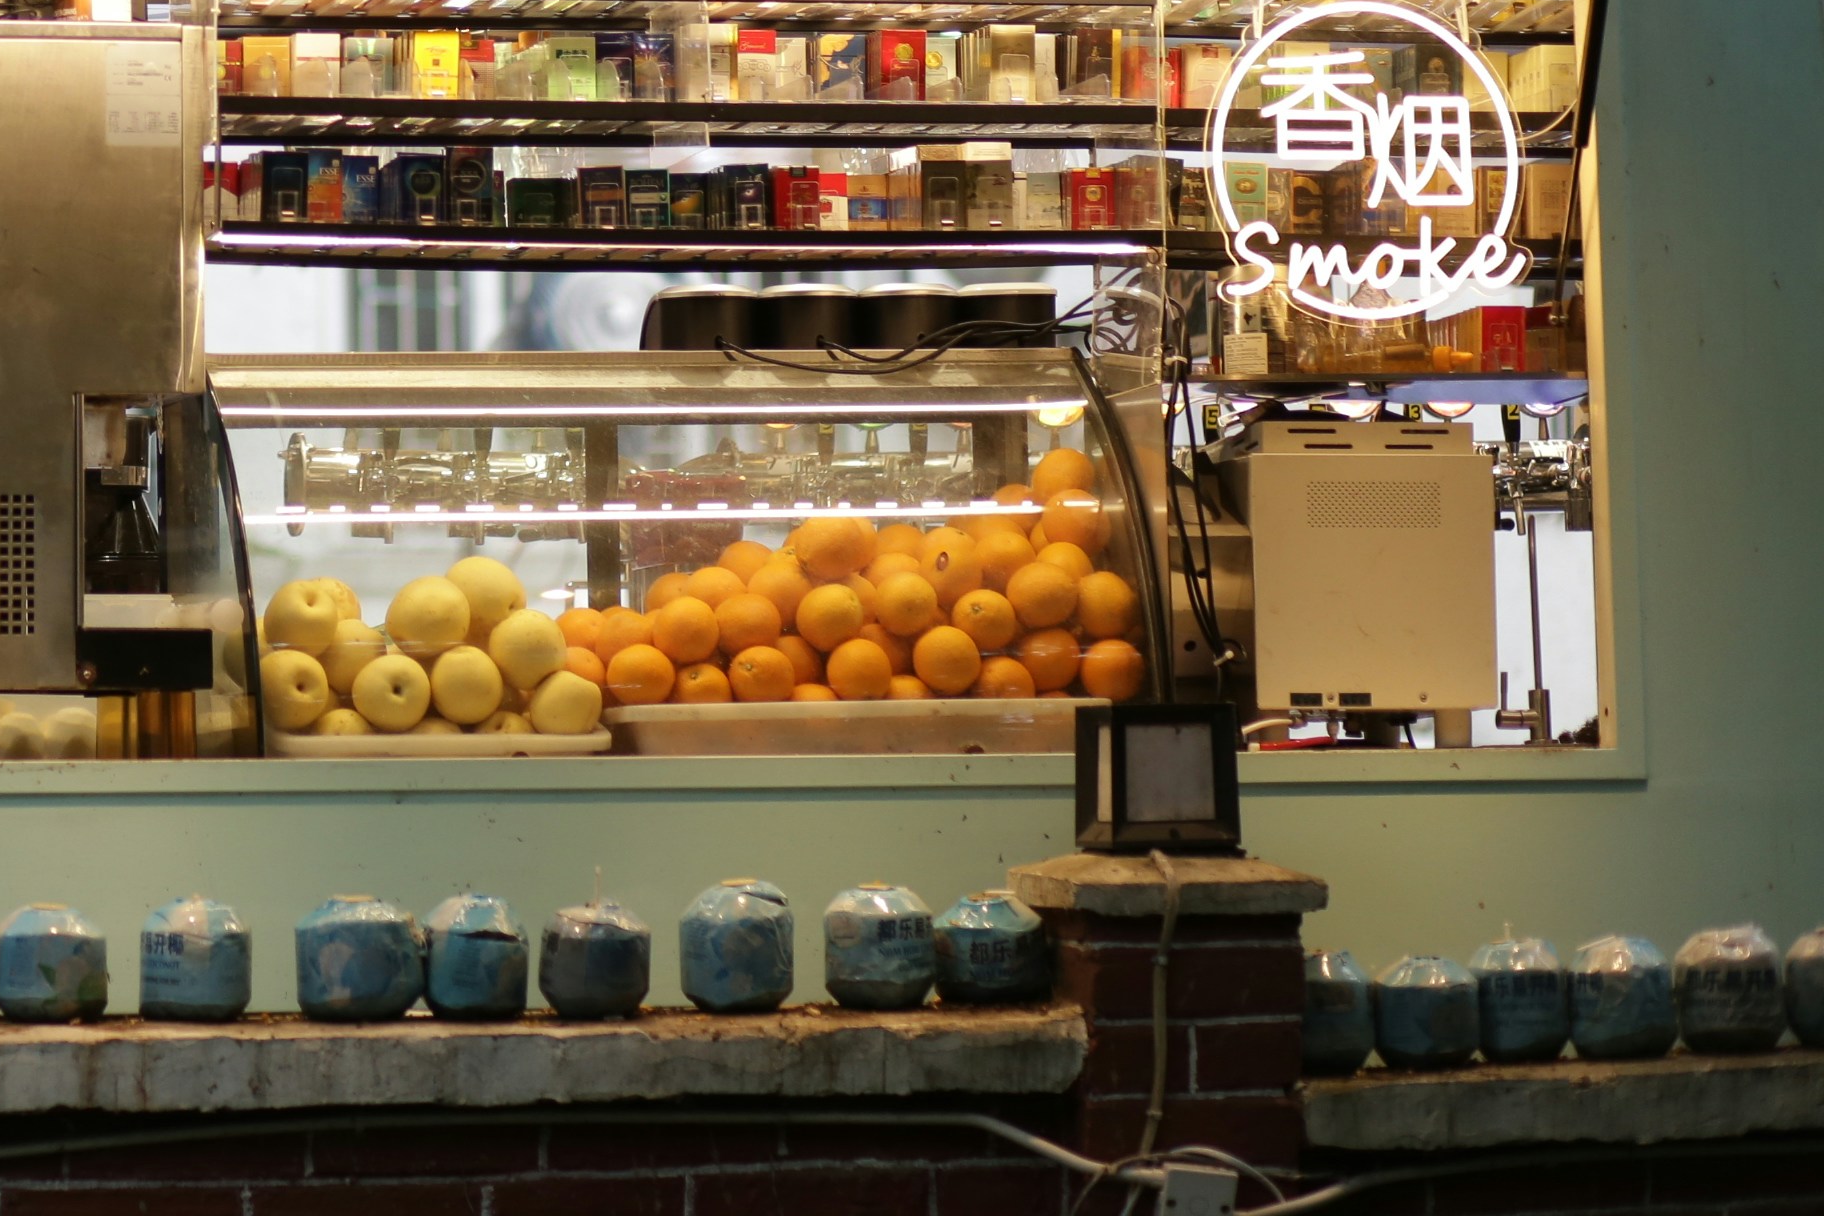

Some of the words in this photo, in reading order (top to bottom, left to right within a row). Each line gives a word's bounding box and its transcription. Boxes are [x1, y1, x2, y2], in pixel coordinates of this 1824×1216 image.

[1259, 50, 1475, 209] 香烟
[1226, 215, 1527, 298] Smoke
[1207, 409, 1218, 424] 5
